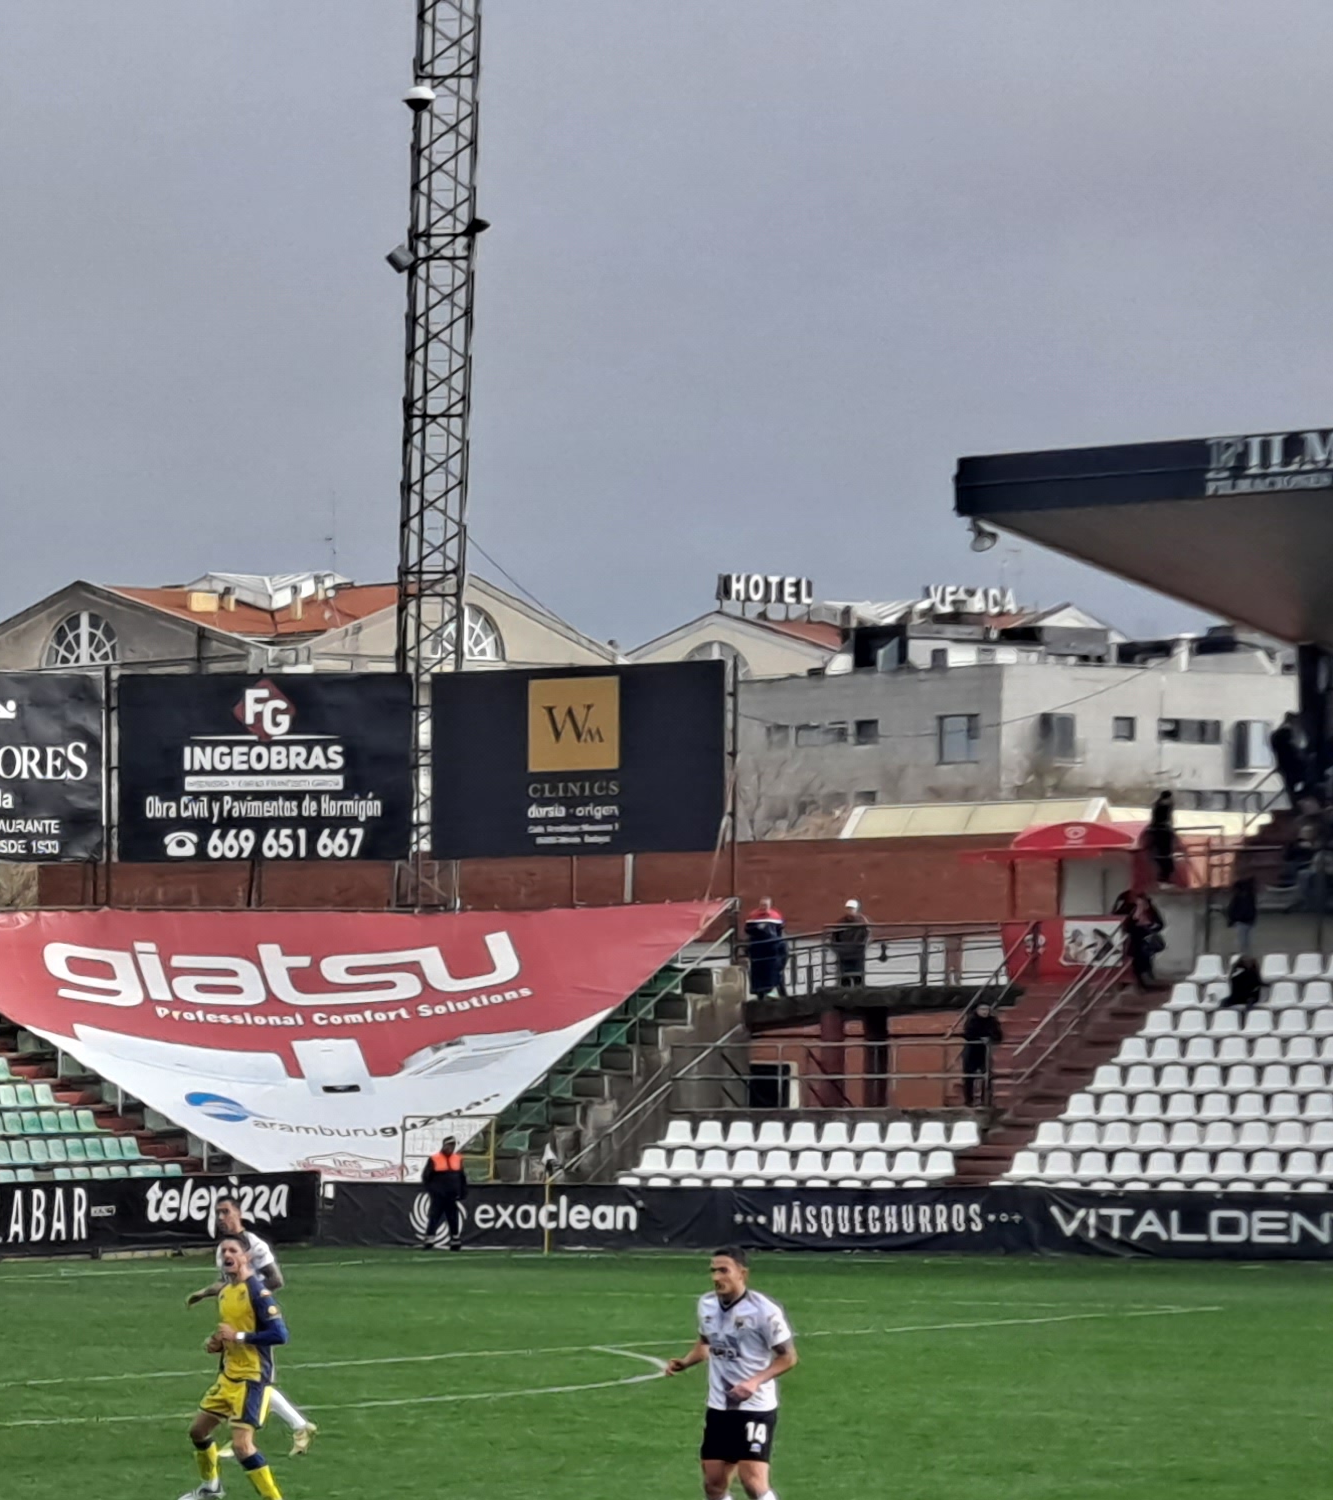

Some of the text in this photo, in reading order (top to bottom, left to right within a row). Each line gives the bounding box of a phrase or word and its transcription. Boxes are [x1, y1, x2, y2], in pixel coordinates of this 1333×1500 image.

[731, 573, 813, 604] HOTEL
[930, 584, 1018, 616] VEADA
[244, 688, 291, 736] FG
[183, 745, 344, 771] INGEOBRAS
[527, 780, 620, 798] CLINICS
[145, 792, 382, 824] Obra Civil y Pavimentos de Hormigón
[207, 828, 365, 859] 669 651 667
[43, 931, 521, 1006] giatsu
[156, 987, 533, 1027] Professional Comfort Solutions
[474, 1195, 637, 1231] exaclean
[1050, 1204, 1333, 1245] VITALDEN
[745, 1421, 767, 1444] 14
